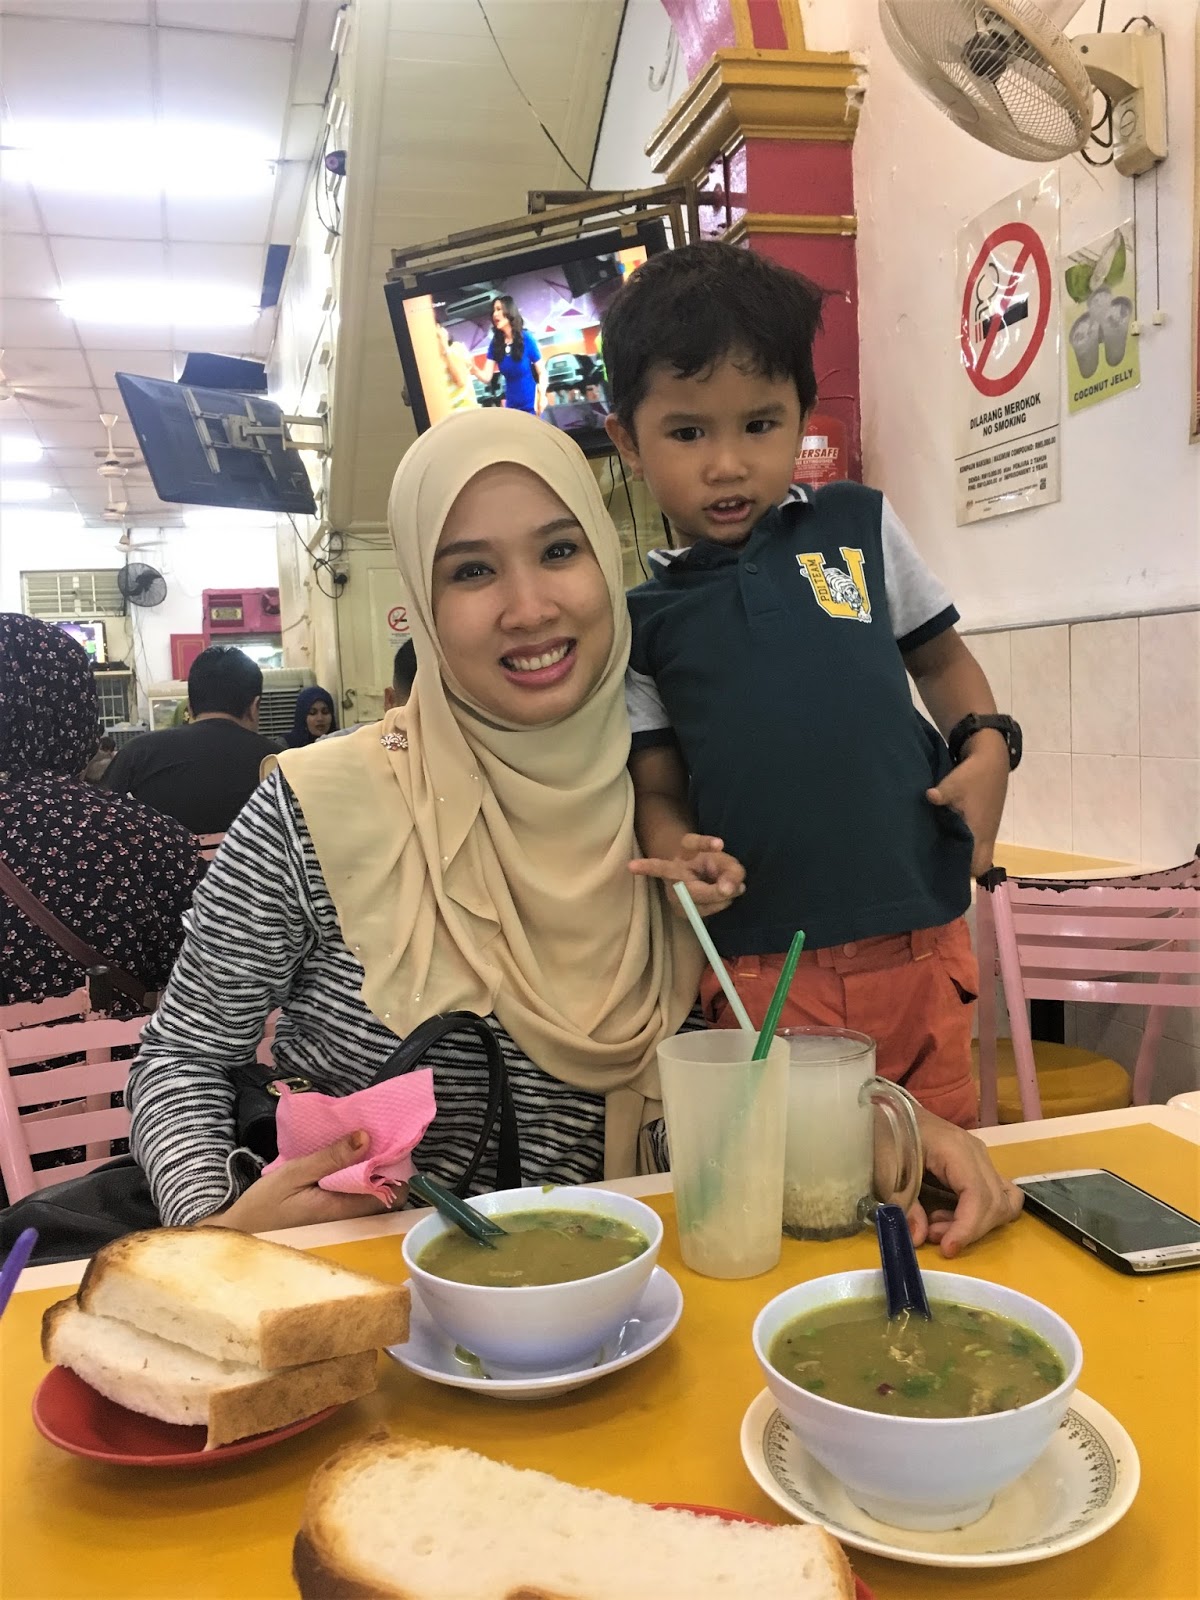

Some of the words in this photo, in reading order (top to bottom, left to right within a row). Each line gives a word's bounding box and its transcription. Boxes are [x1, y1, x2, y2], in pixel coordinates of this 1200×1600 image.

[1074, 379, 1109, 401] COCONUT
[1110, 368, 1133, 386] JELLY
[970, 408, 1002, 429] DILARANG
[1004, 392, 1041, 416] MEROKOK
[983, 425, 992, 437] NO
[994, 413, 1026, 433] SMOKING
[807, 559, 824, 584] TEAM
[817, 586, 830, 602] PDI
